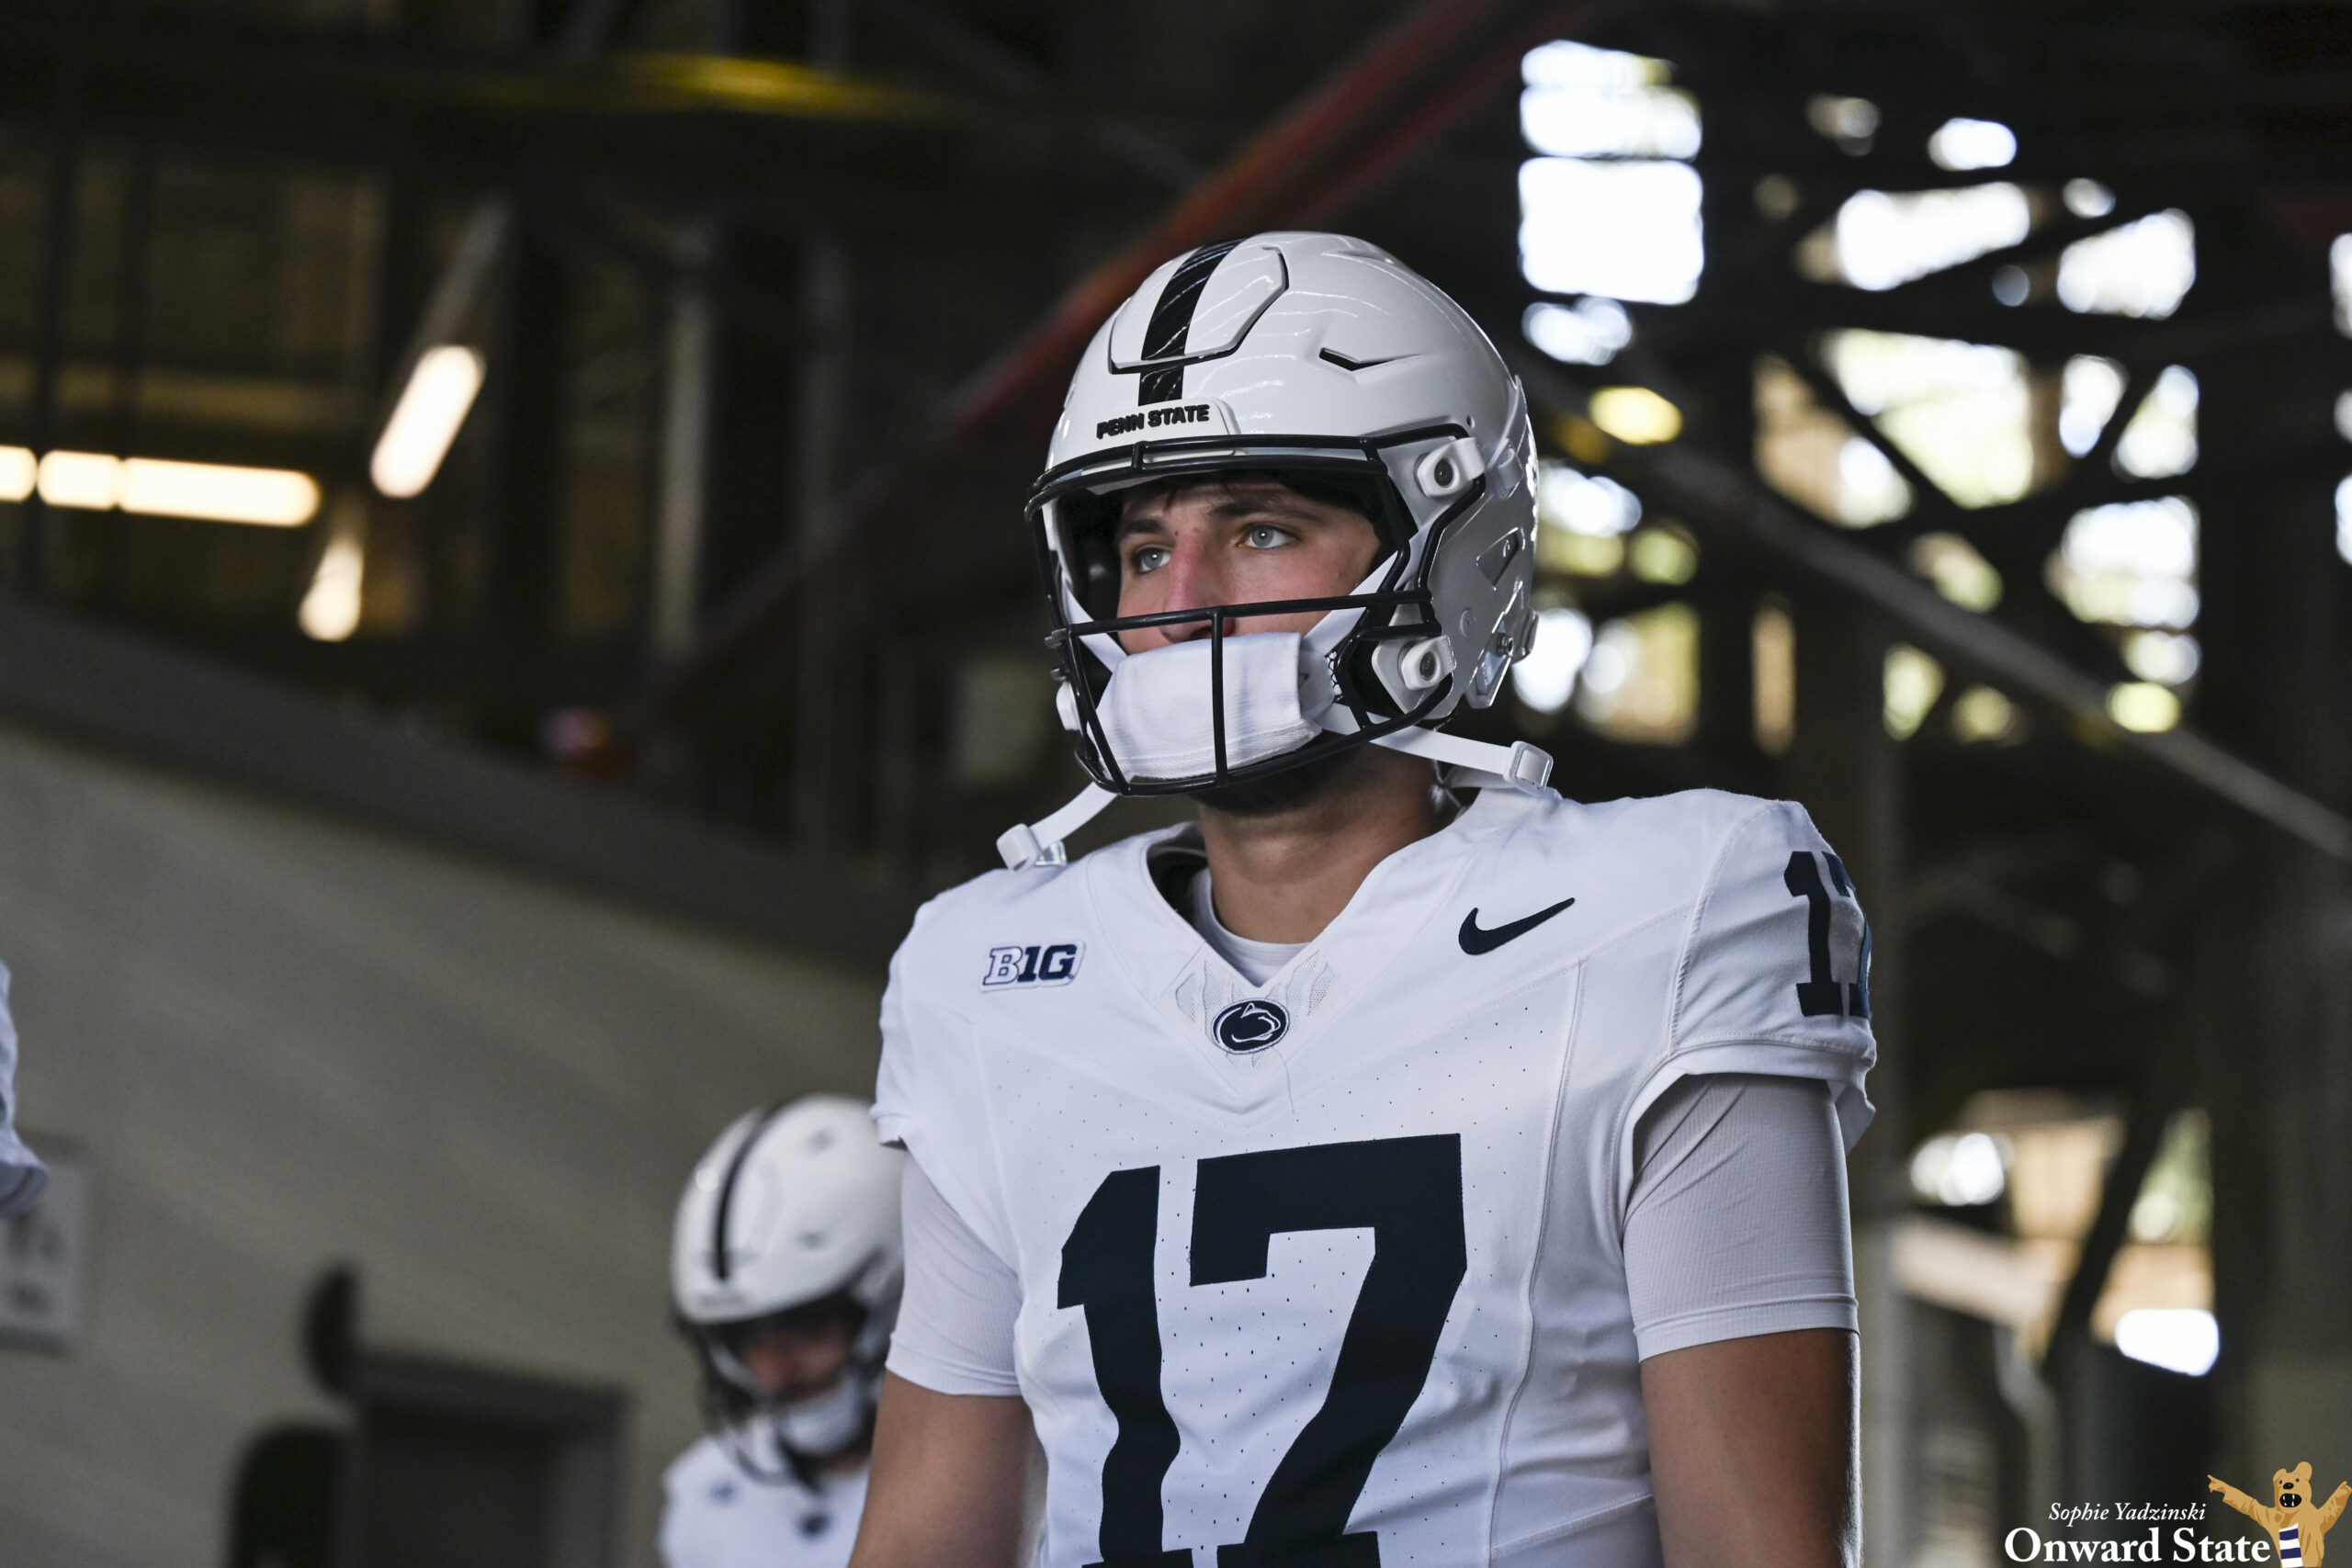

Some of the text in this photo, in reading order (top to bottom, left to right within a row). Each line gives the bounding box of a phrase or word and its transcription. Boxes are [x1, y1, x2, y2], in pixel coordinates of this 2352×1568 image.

[1096, 404, 1210, 439] PENN STATE
[1057, 1133, 1467, 1568] 17
